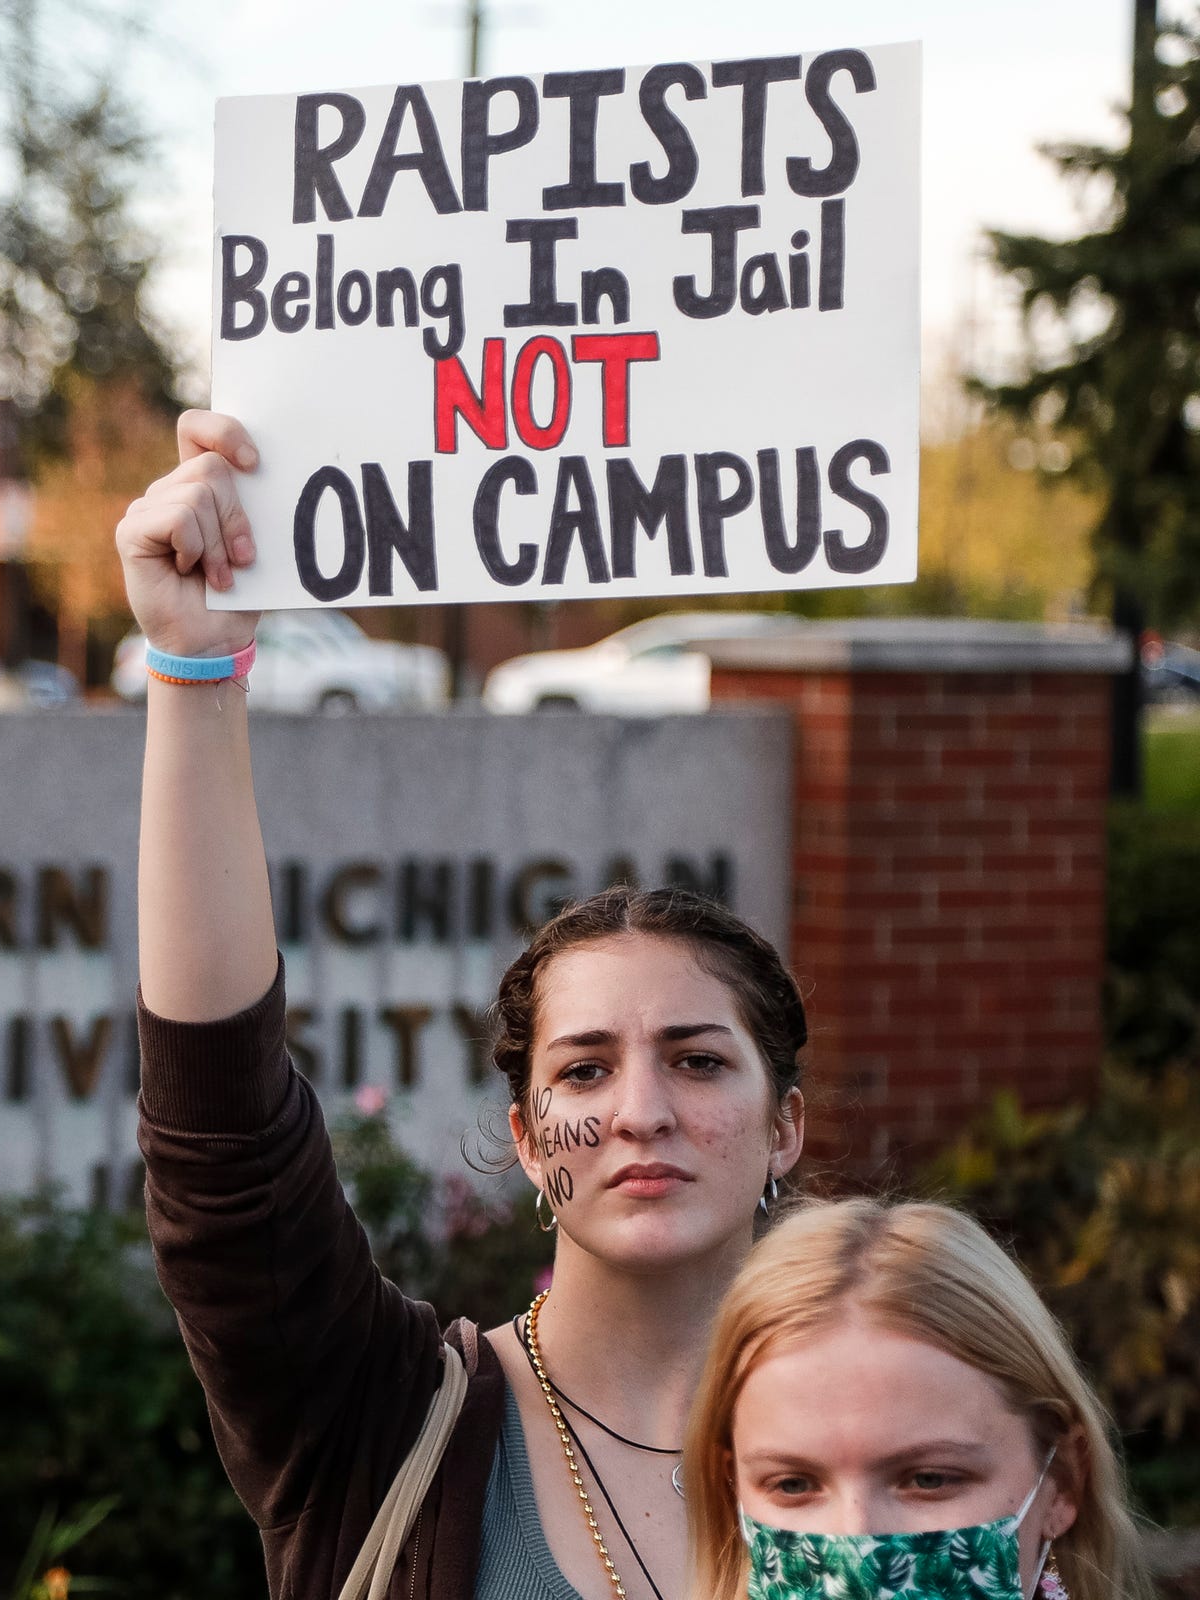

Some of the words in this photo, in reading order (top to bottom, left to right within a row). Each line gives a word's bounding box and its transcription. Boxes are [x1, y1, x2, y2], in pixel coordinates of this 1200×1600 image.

[293, 47, 877, 224] RAPISTS
[220, 233, 466, 360] Belong
[503, 216, 631, 327] In
[672, 198, 846, 319] Jail
[433, 330, 661, 454] NOT
[293, 460, 439, 602] ON
[472, 438, 892, 586] CAMPUS
[546, 1165, 574, 1208] NO
